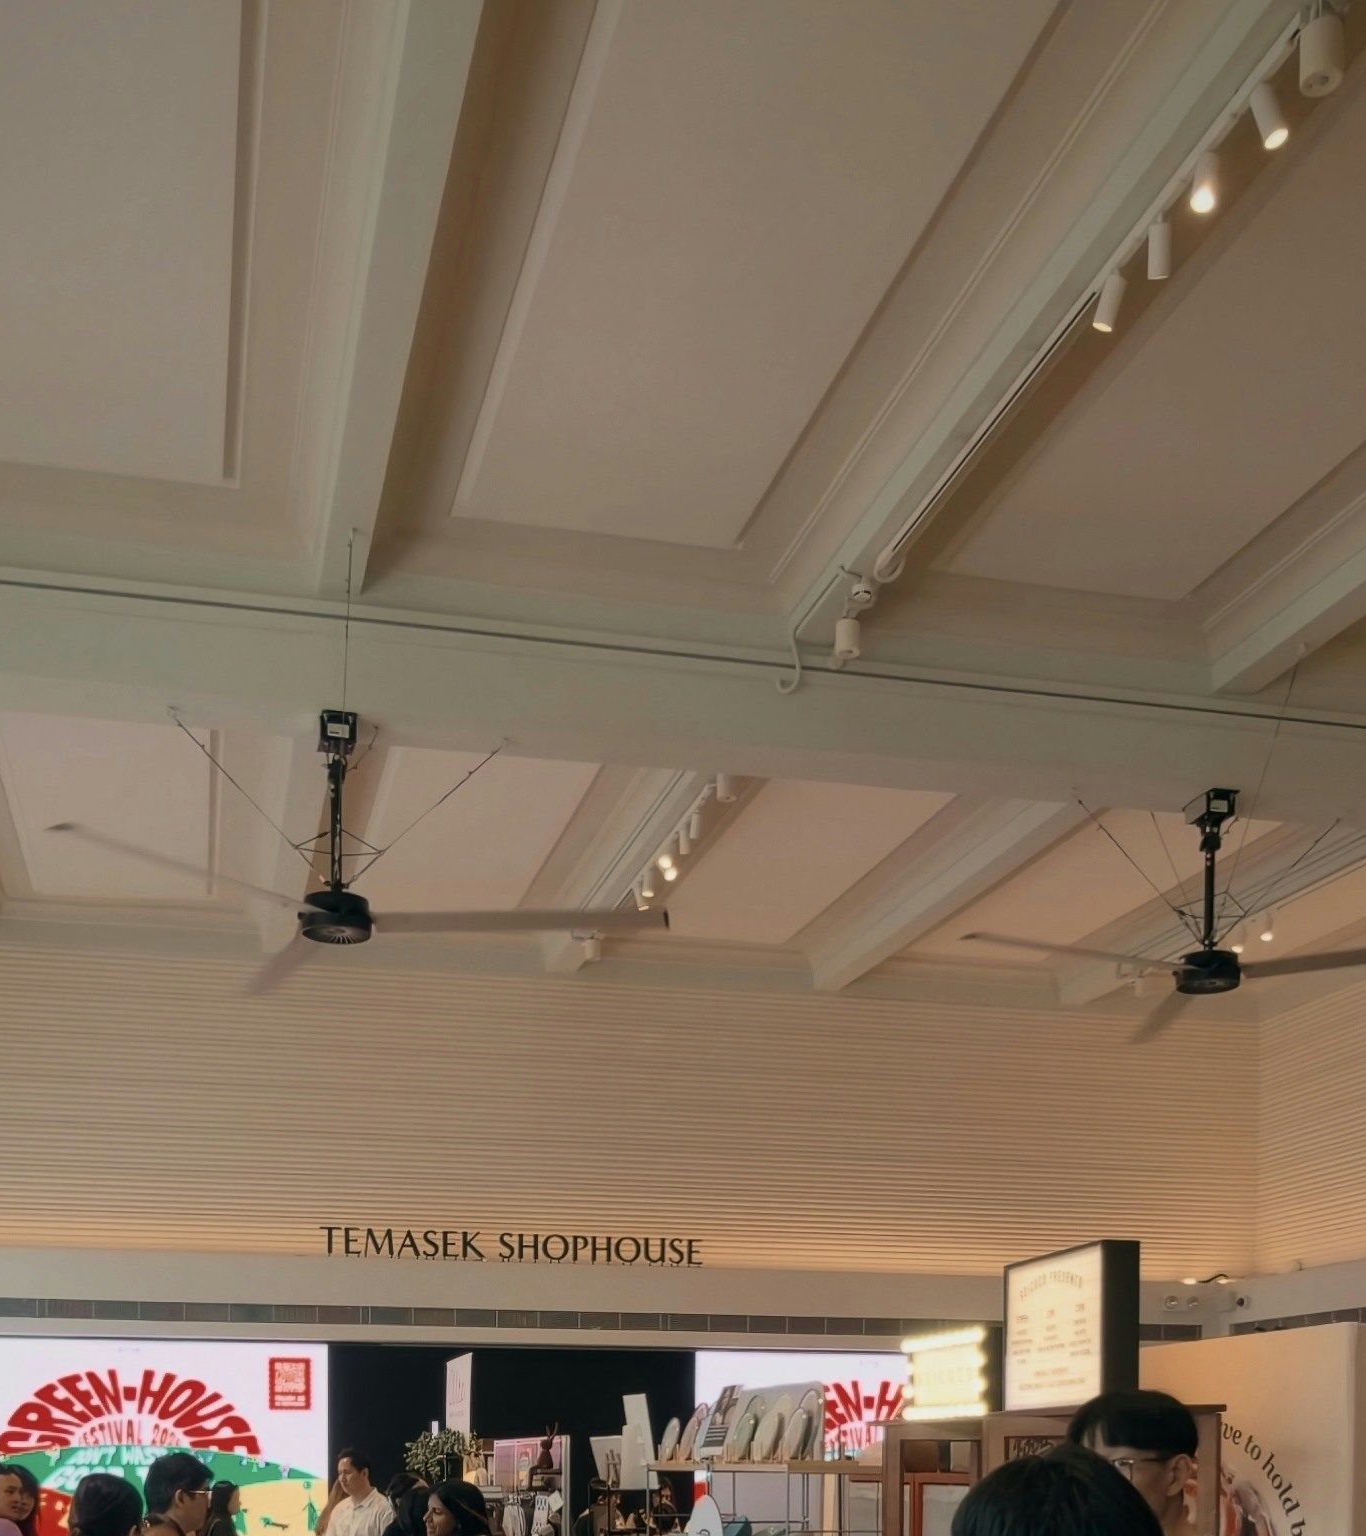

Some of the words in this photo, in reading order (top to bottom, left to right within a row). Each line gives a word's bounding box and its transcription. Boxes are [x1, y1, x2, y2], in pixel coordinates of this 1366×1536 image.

[319, 1226, 486, 1261] TEMASEK
[498, 1232, 705, 1267] SHOPHOUSE
[1244, 1434, 1262, 1461] to
[1261, 1452, 1300, 1517] hold
